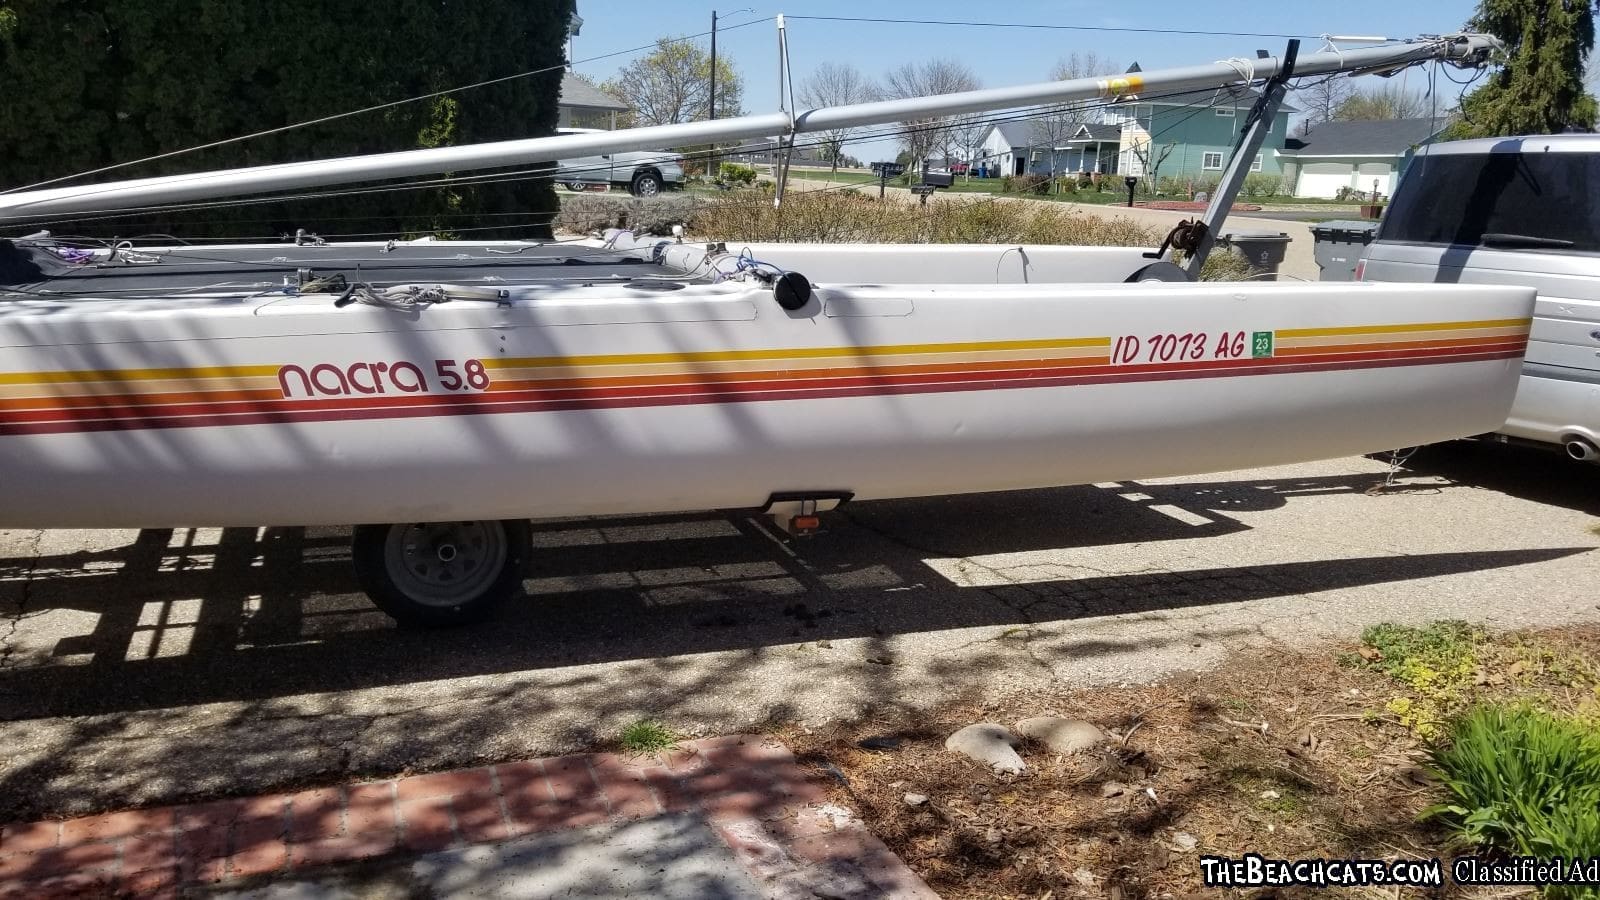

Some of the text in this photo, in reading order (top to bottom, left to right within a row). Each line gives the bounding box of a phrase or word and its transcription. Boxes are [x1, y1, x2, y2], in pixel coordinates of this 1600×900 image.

[1112, 330, 1246, 364] ID 7073 AG
[1255, 338, 1269, 350] 23
[278, 359, 490, 397] nacra 5.8
